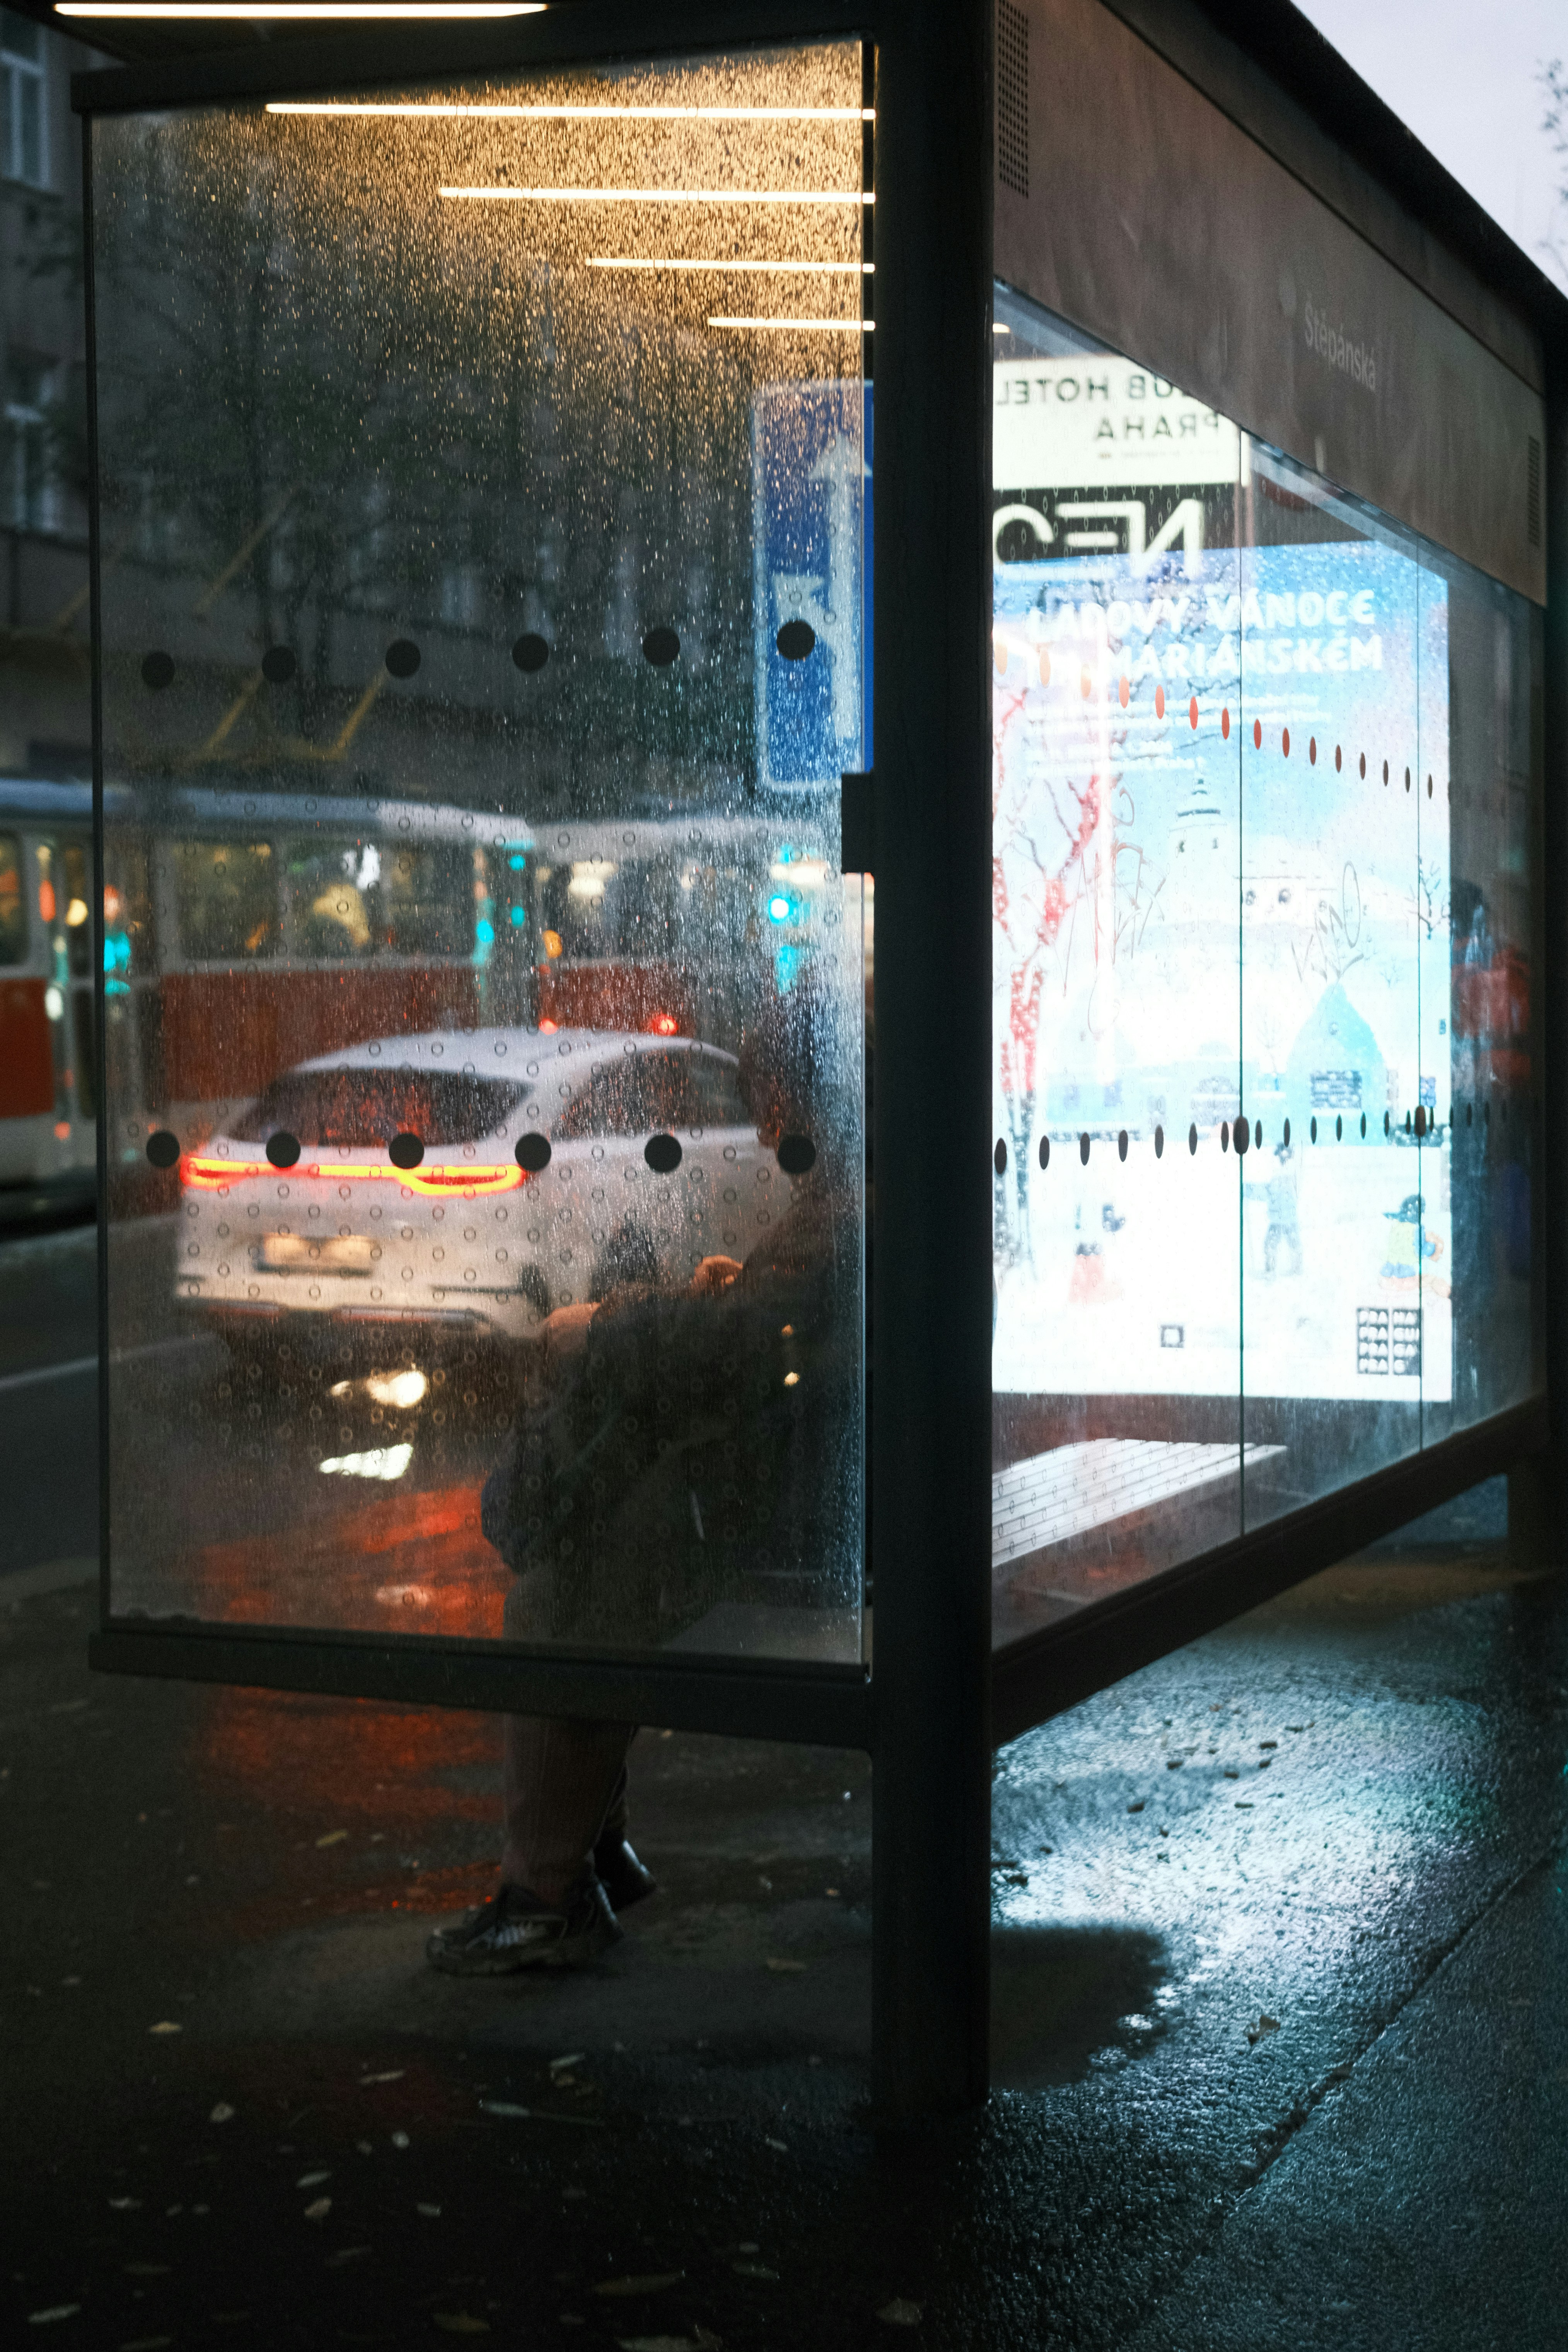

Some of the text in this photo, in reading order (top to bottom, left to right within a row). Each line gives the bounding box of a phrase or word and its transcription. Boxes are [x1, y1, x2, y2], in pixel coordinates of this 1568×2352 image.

[1305, 291, 1376, 392] Štěpánská
[1204, 587, 1375, 632] VÁNOCE
[1358, 1311, 1416, 1324] PRA HA
[1358, 1327, 1388, 1340] PRA
[1358, 1342, 1416, 1357] PRA GA
[1358, 1358, 1388, 1372] PRA
